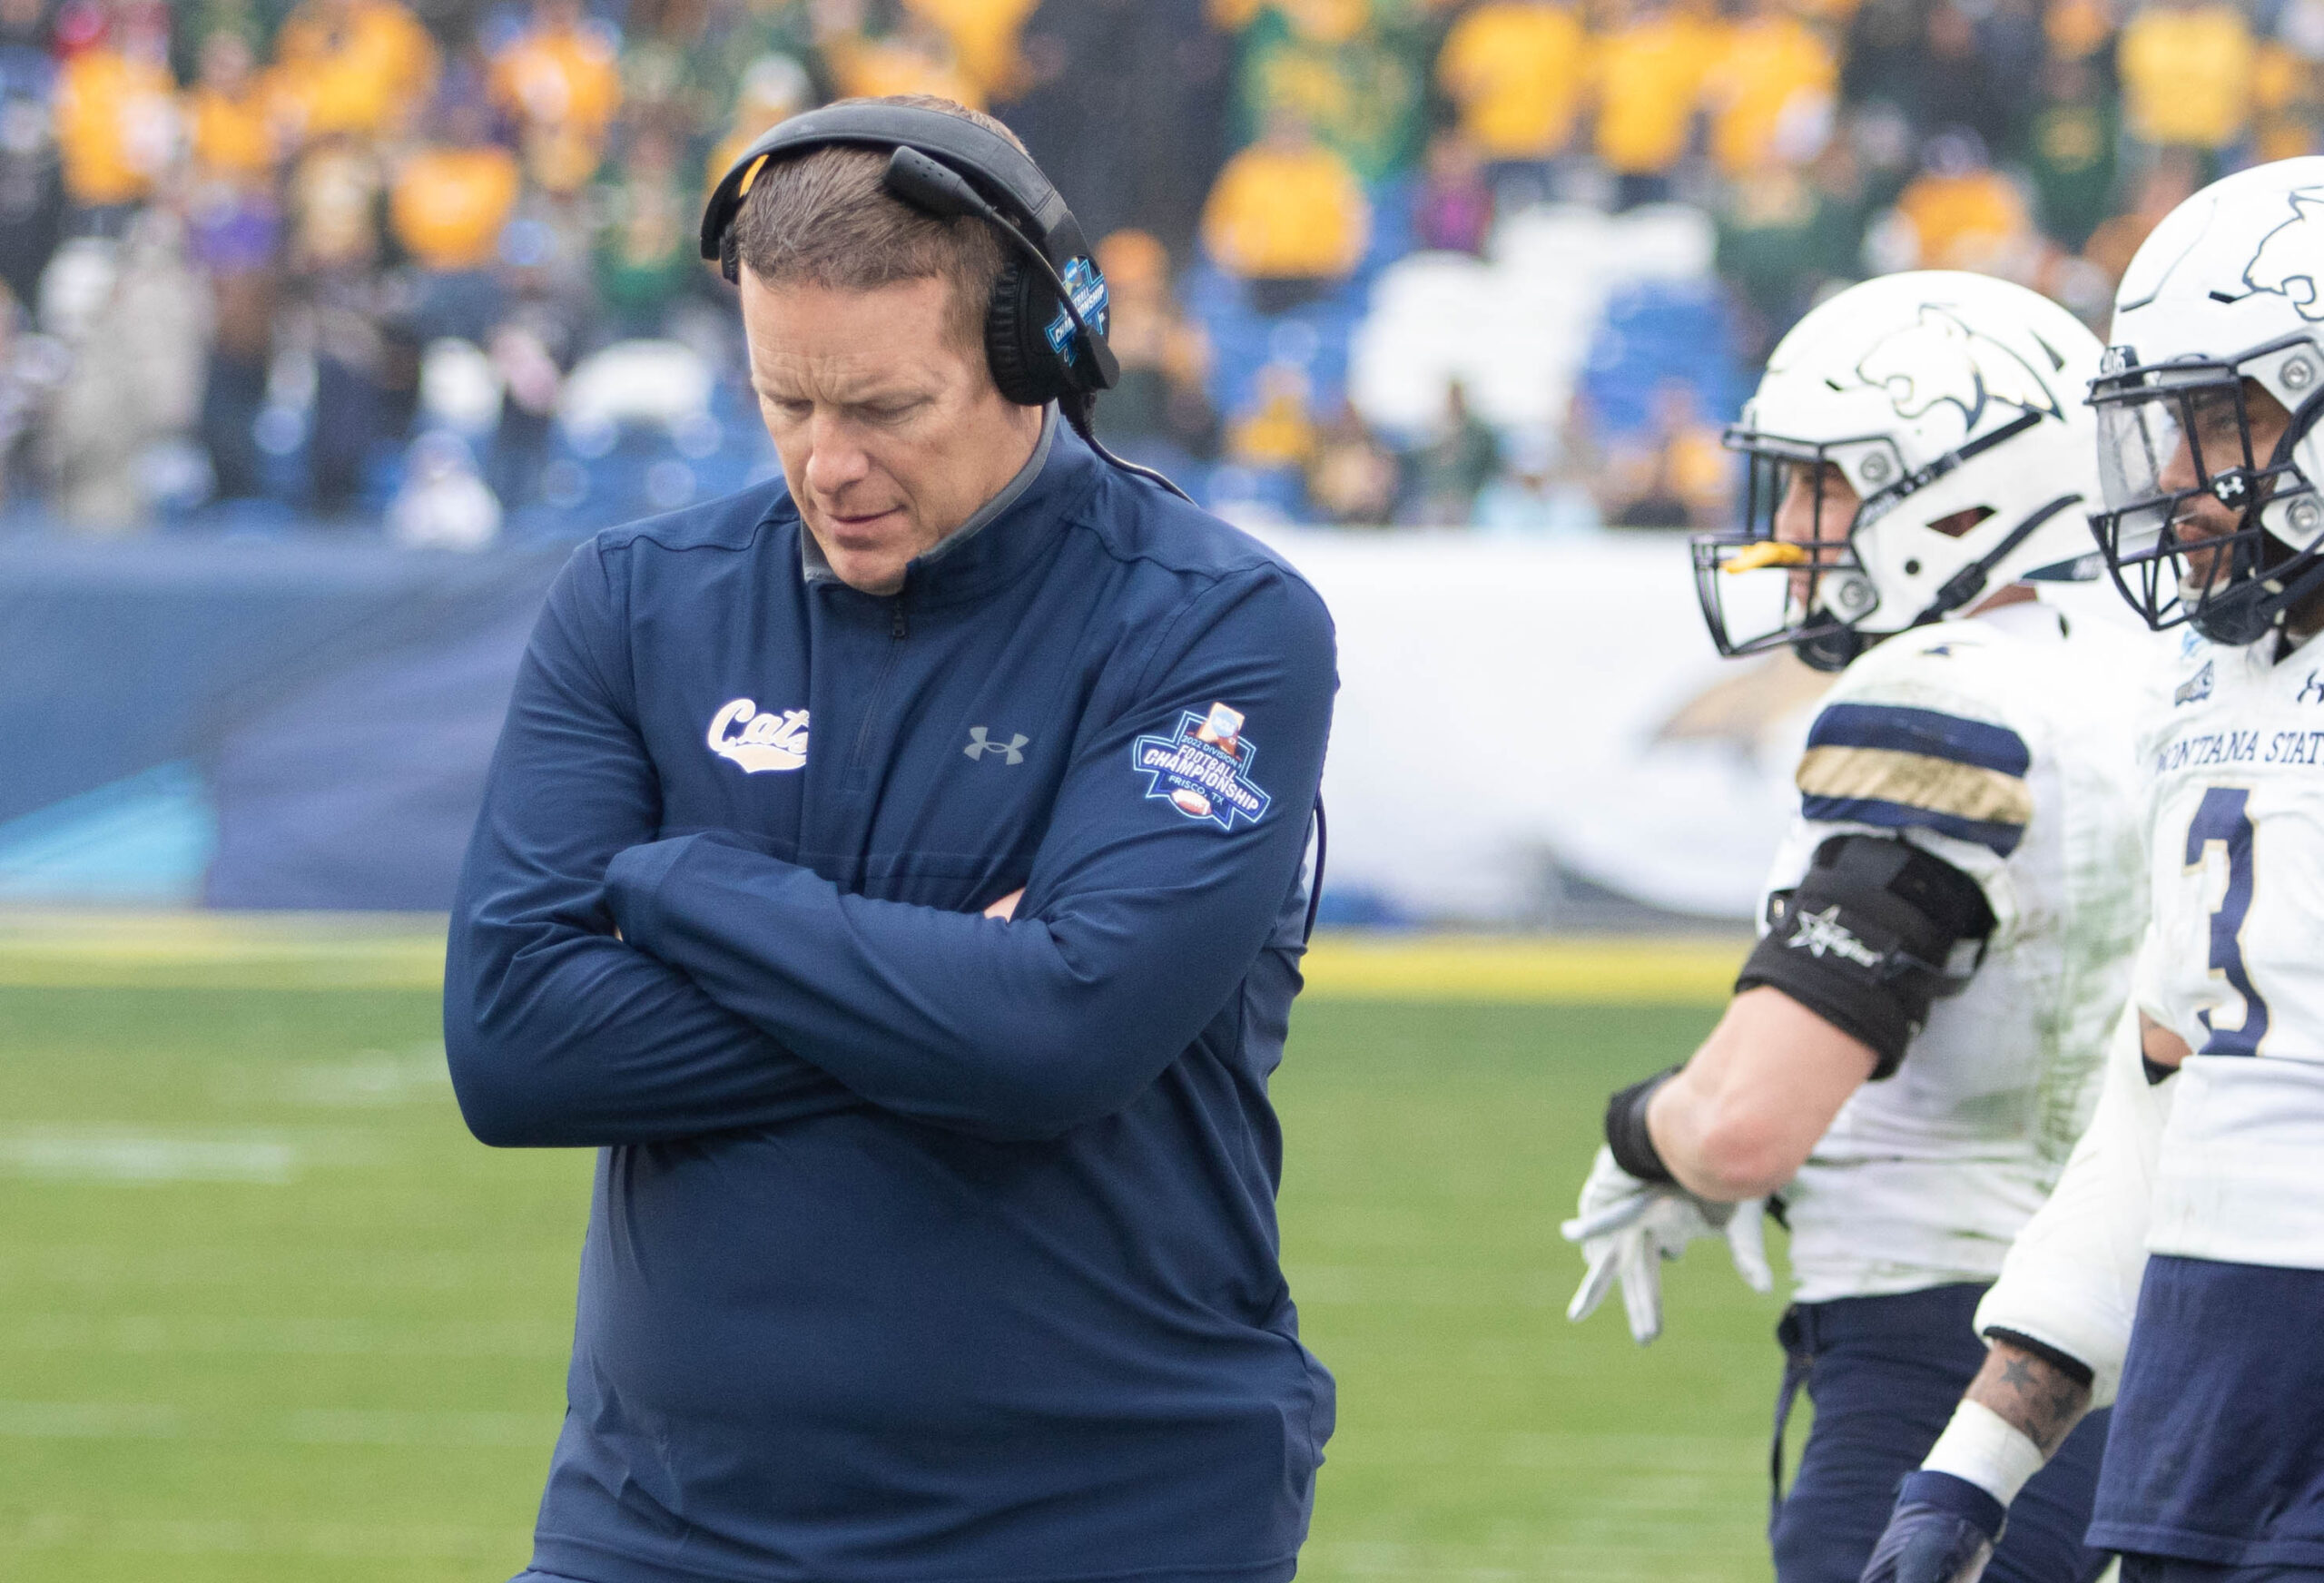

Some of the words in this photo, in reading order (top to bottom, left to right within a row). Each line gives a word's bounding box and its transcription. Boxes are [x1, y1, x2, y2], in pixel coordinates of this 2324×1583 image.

[1177, 744, 1237, 783] FOOTBALL
[1181, 735, 1203, 748] 2022
[1203, 743, 1238, 767] DIVISION
[2265, 731, 2324, 765] STAT
[1144, 749, 1259, 811] CHAMPIONSHIP
[1169, 775, 1207, 797] FRISCO,
[1212, 791, 1225, 806] TX
[2182, 784, 2271, 1057] 3
